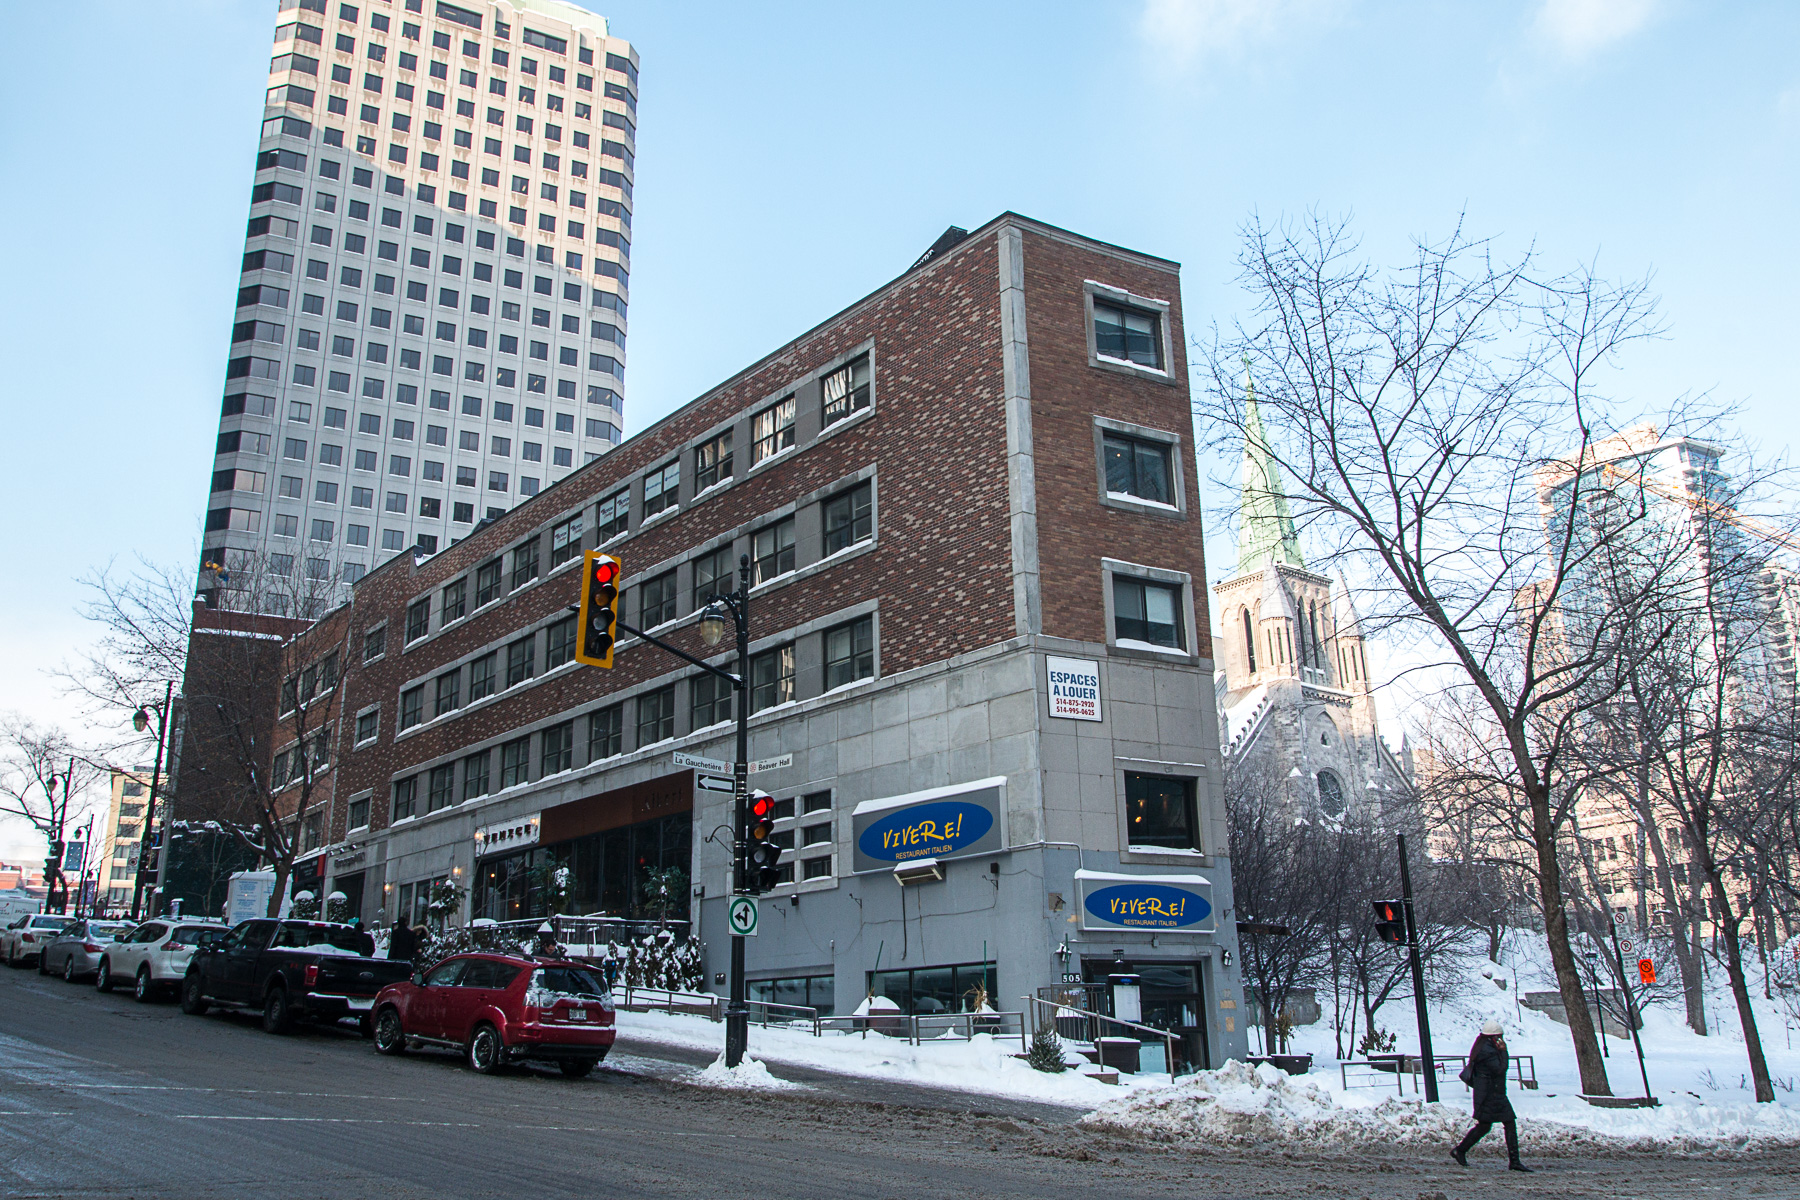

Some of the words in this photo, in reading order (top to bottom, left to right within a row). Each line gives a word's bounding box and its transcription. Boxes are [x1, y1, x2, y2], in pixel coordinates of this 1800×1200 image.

[1050, 670, 1097, 687] ESPACES
[1063, 686, 1096, 700] LOUER
[1056, 698, 1095, 708] 514-875-2920
[1056, 706, 1095, 716] 514-995-0625
[675, 756, 683, 764] La
[685, 758, 721, 771] Gauchetière
[758, 762, 777, 771] Beaver
[780, 758, 790, 766] Hall
[895, 848, 931, 860] RESTAURANT
[931, 845, 953, 854] ITALIEN
[1158, 919, 1178, 927] ITALIEN
[1062, 974, 1081, 983] 505
